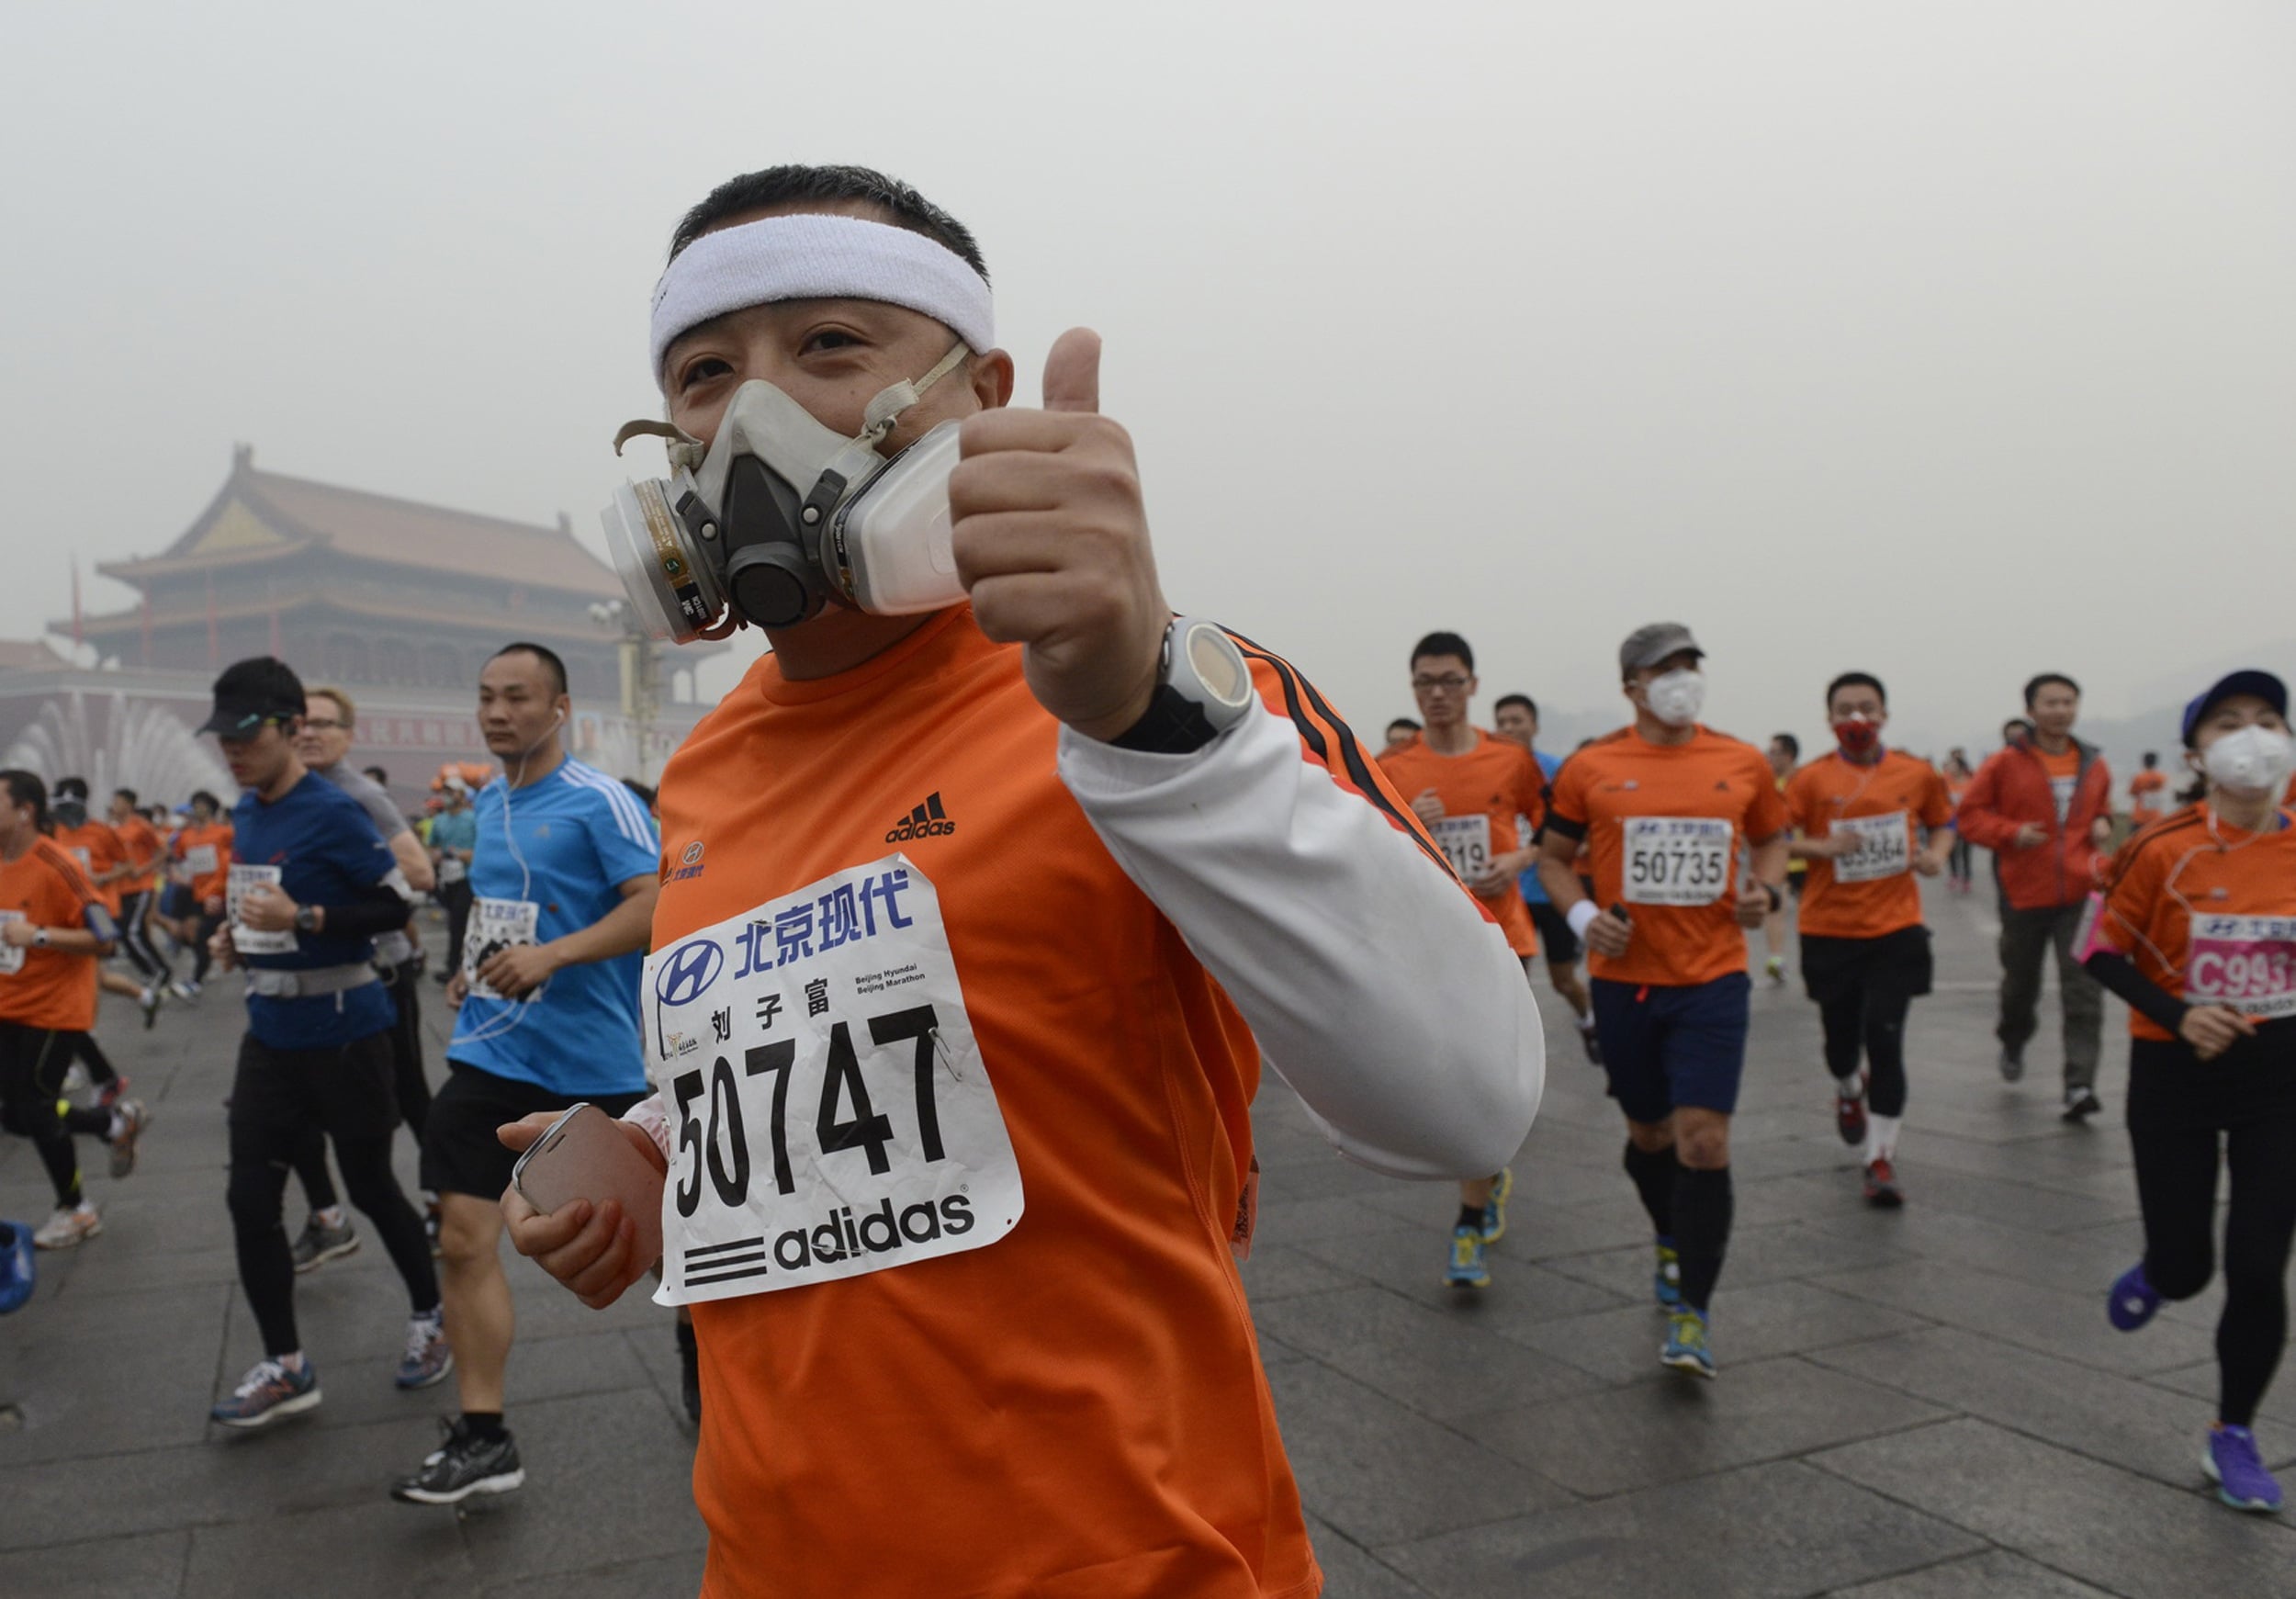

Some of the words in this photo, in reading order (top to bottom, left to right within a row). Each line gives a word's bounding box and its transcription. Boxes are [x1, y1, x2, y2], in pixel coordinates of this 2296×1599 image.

[681, 600, 694, 616] 3M
[885, 820, 955, 843] adidas
[1632, 850, 1723, 884] 50735
[735, 869, 913, 980] 北京现代
[855, 973, 883, 985] Beijing
[884, 963, 917, 977] Hyundai
[857, 983, 884, 995] Beijing
[885, 974, 926, 987] Marathon
[2191, 952, 2296, 997] C993
[673, 1004, 946, 1218] 50747
[773, 1195, 975, 1270] adidas
